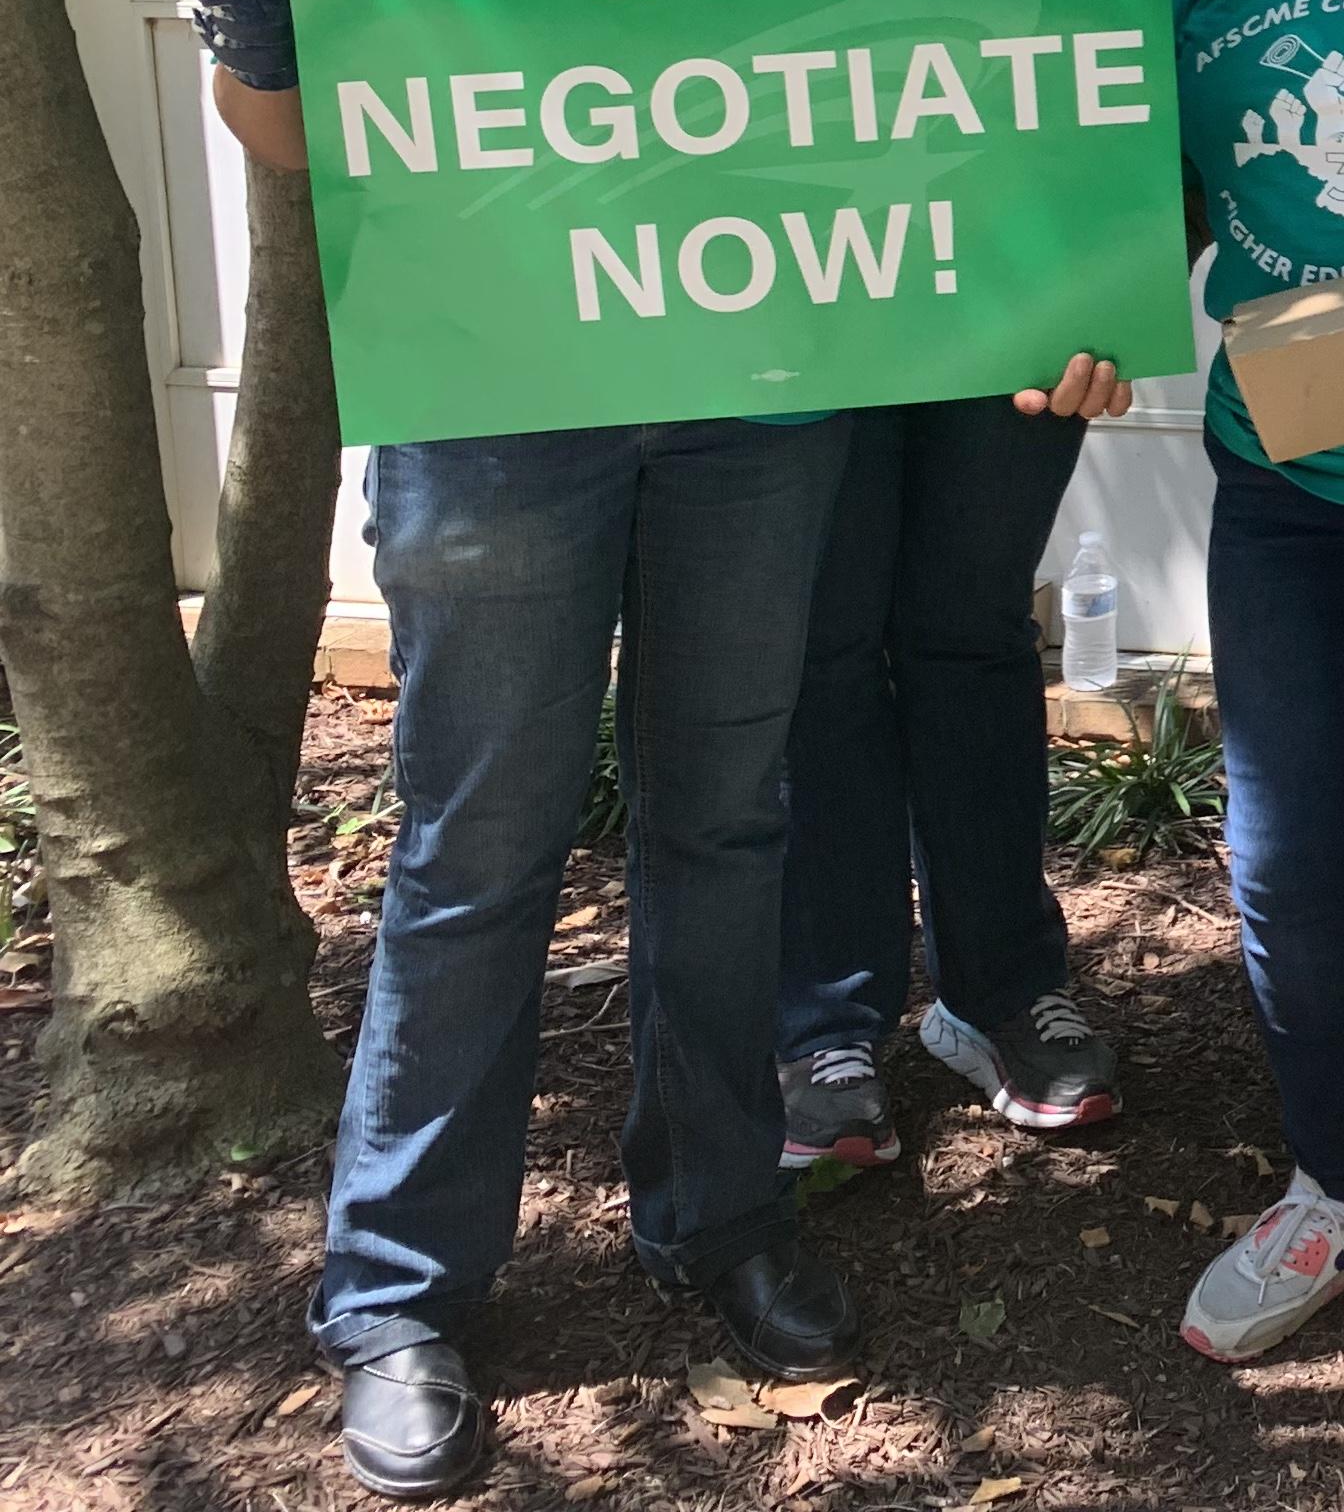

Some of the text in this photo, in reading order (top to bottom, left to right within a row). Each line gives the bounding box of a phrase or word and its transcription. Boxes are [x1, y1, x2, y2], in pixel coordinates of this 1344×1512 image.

[337, 30, 1152, 177] NEGOTIATE
[569, 201, 957, 322] NOW!
[1219, 190, 1292, 282] HIGHER
